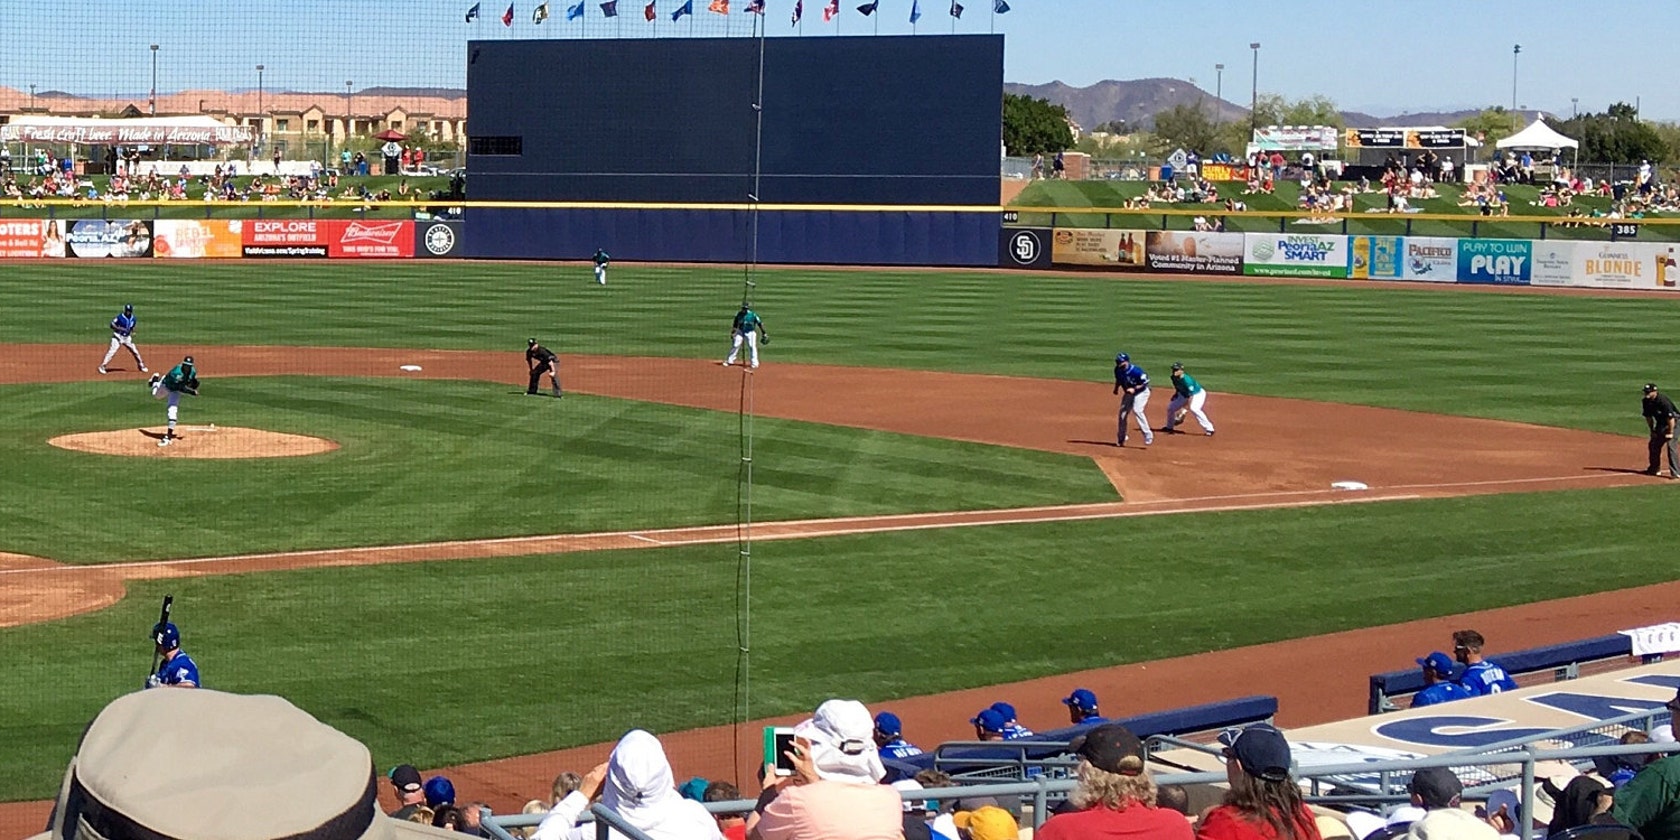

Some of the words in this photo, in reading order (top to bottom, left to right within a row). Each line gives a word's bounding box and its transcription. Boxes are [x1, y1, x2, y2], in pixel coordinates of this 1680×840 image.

[254, 222, 317, 232] EXPLORE
[1617, 225, 1636, 234] 385
[1463, 243, 1488, 252] PLAY
[1490, 243, 1504, 252] TO
[1506, 244, 1527, 253] WIN
[1285, 251, 1328, 261] SMART
[1152, 261, 1195, 270] Community
[1197, 262, 1205, 270] in
[1206, 263, 1236, 271] Arizona
[1471, 255, 1526, 275] PLAY
[1586, 259, 1642, 276] BLONDE
